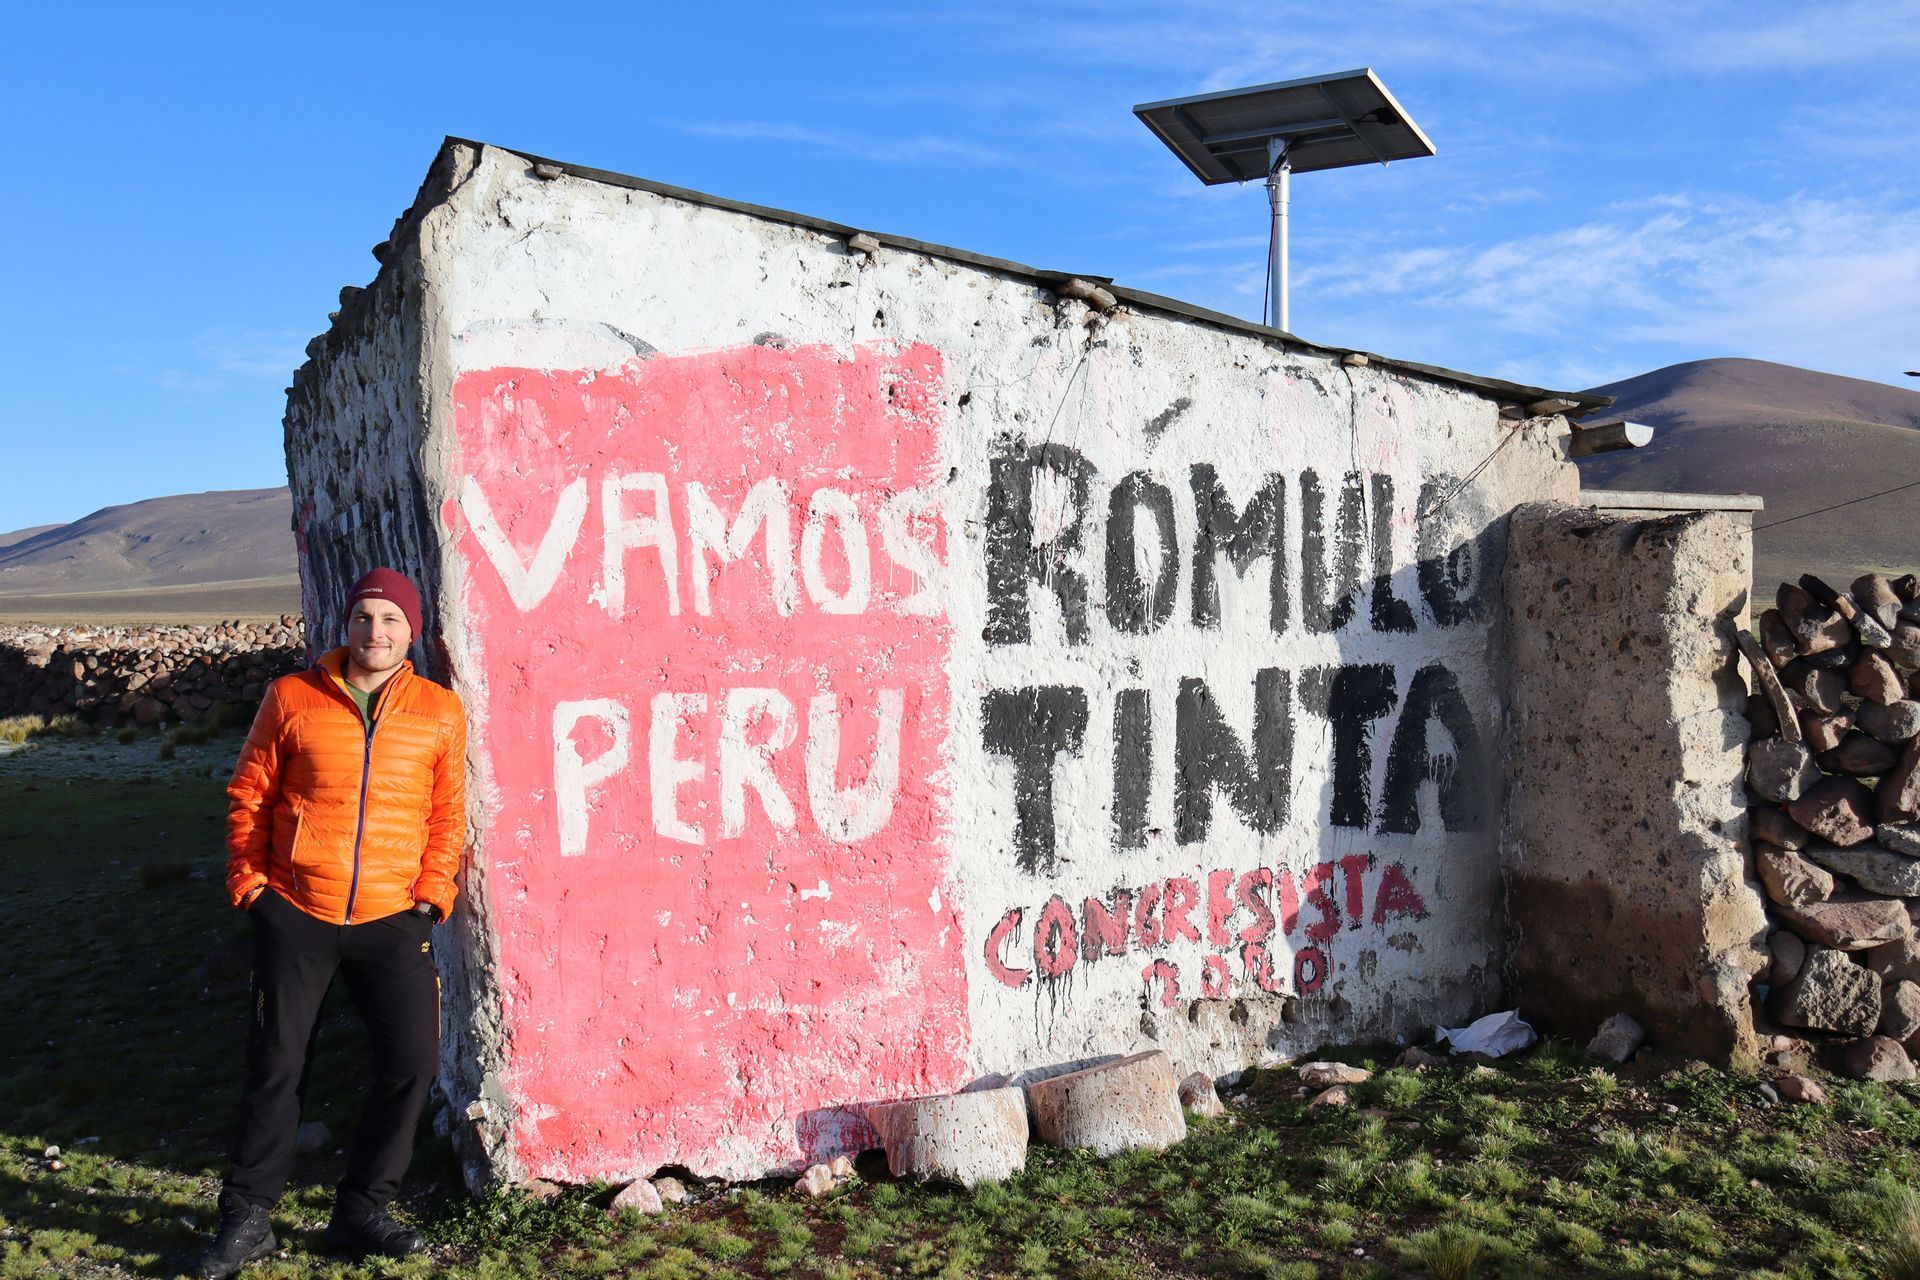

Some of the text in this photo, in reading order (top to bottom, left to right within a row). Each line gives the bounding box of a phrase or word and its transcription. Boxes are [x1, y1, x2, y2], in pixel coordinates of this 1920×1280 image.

[461, 470, 948, 617] VAMOS
[553, 687, 904, 856] PERU
[979, 662, 1490, 880] TINTA
[984, 853, 1430, 990] CONGRESISTA
